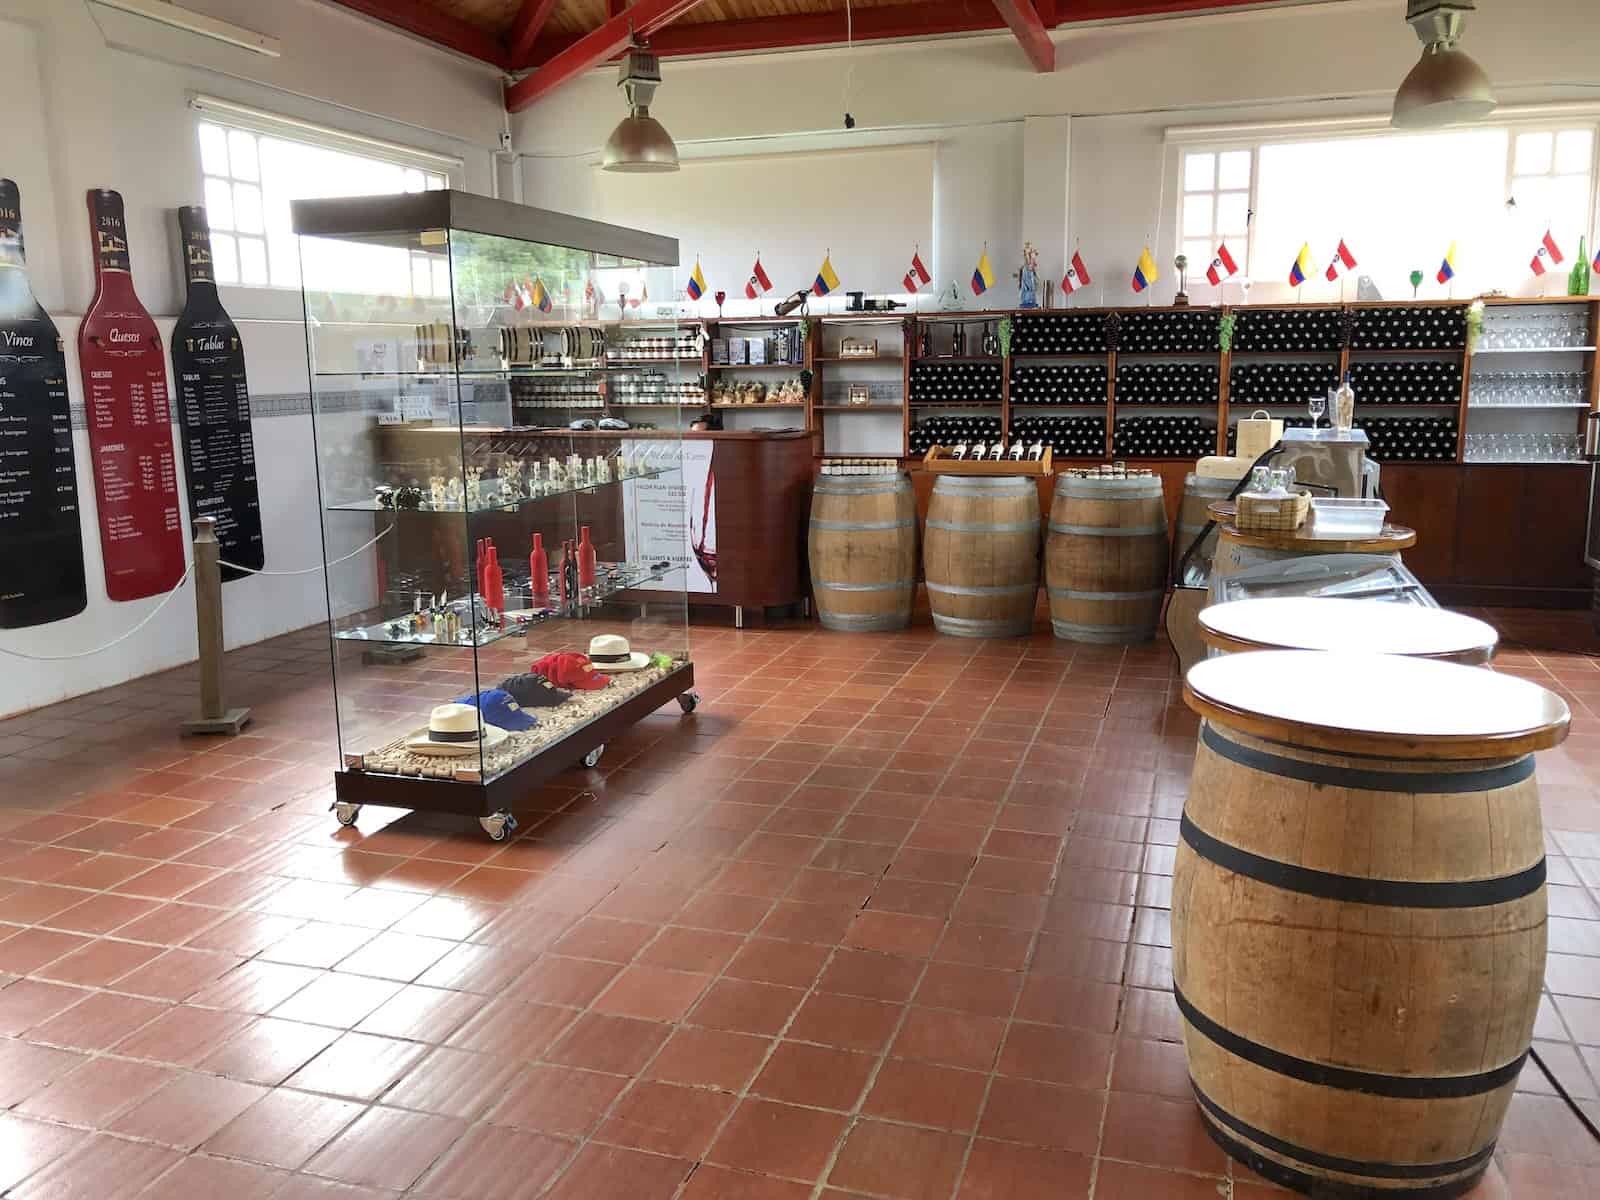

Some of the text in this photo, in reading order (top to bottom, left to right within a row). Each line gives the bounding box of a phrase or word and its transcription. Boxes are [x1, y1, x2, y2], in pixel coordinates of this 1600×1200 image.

[101, 216, 121, 227] 2016
[1, 331, 34, 347] Vinos
[109, 328, 140, 343] Quesos
[197, 335, 225, 351] Tablas
